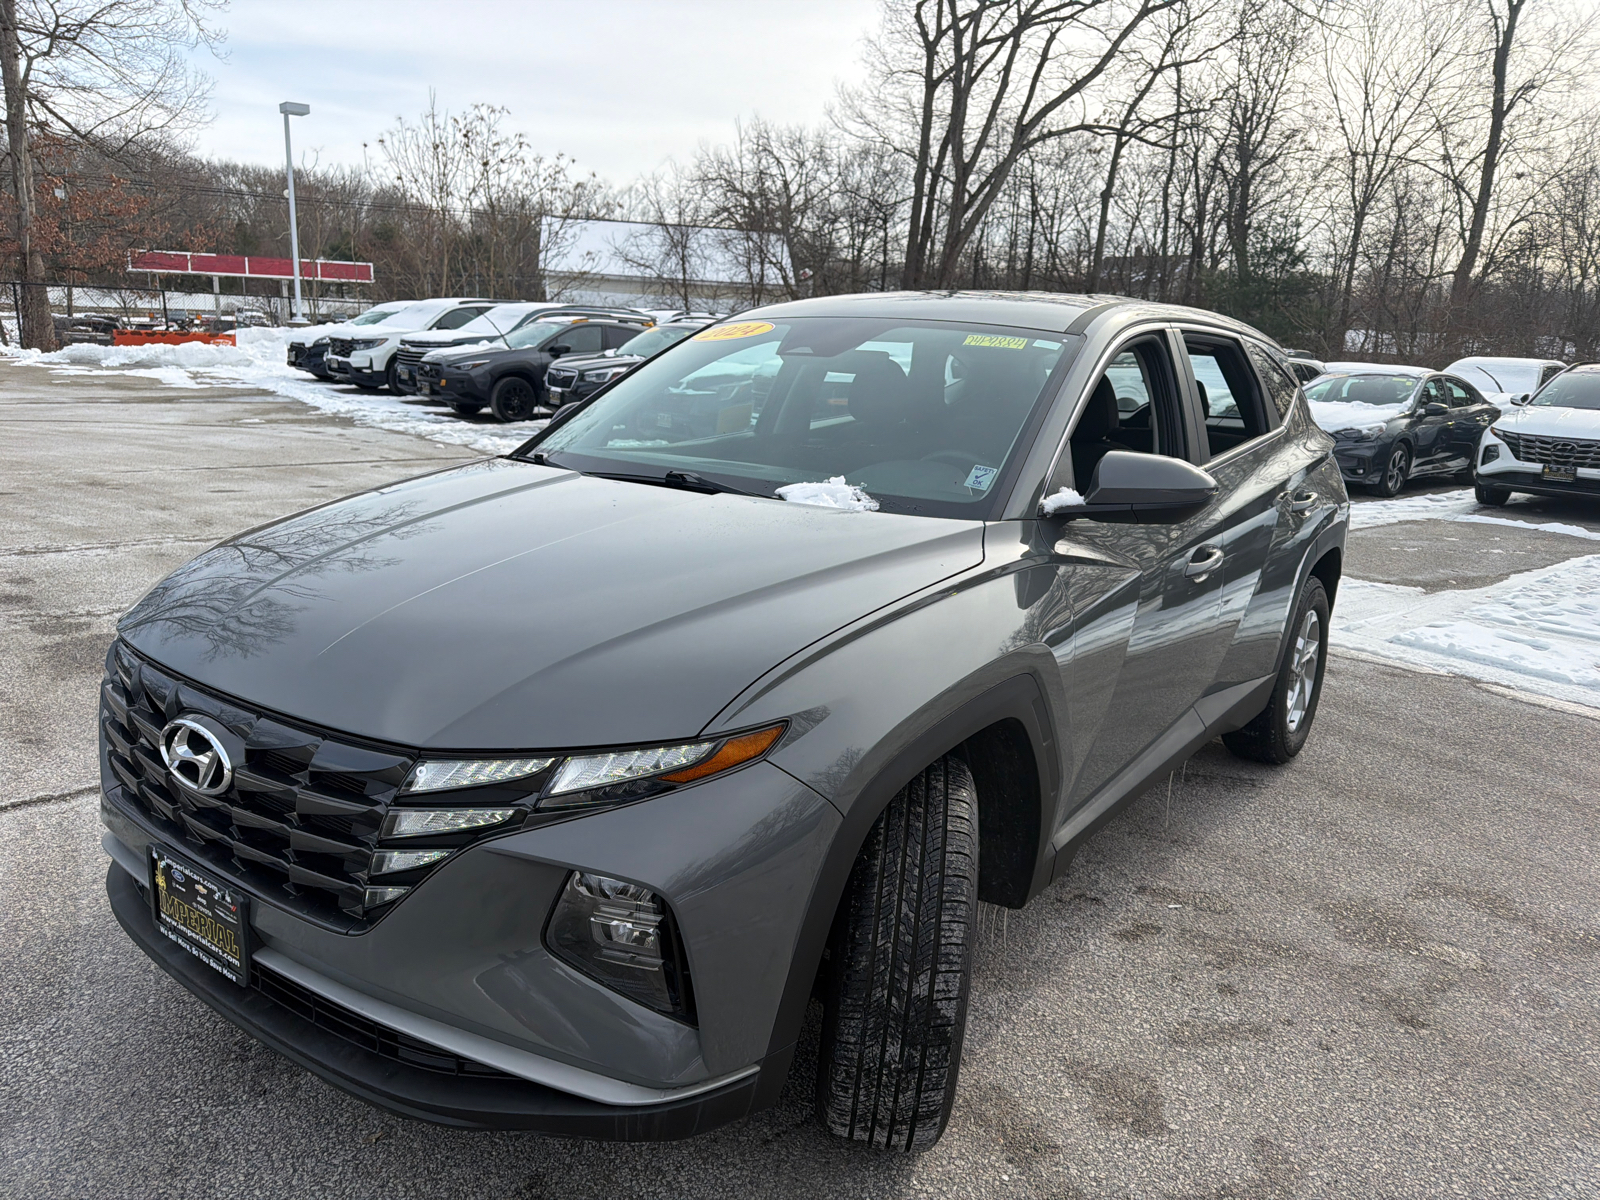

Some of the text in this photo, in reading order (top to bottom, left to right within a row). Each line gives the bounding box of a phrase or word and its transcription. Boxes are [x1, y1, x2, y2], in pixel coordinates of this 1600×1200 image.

[700, 325, 766, 338] 2024
[974, 466, 995, 474] SAFETY
[159, 888, 240, 958] IMPERIAL
[160, 911, 241, 968] www.imperialcars.com
[159, 925, 237, 982] We Sell More, So You Save More
